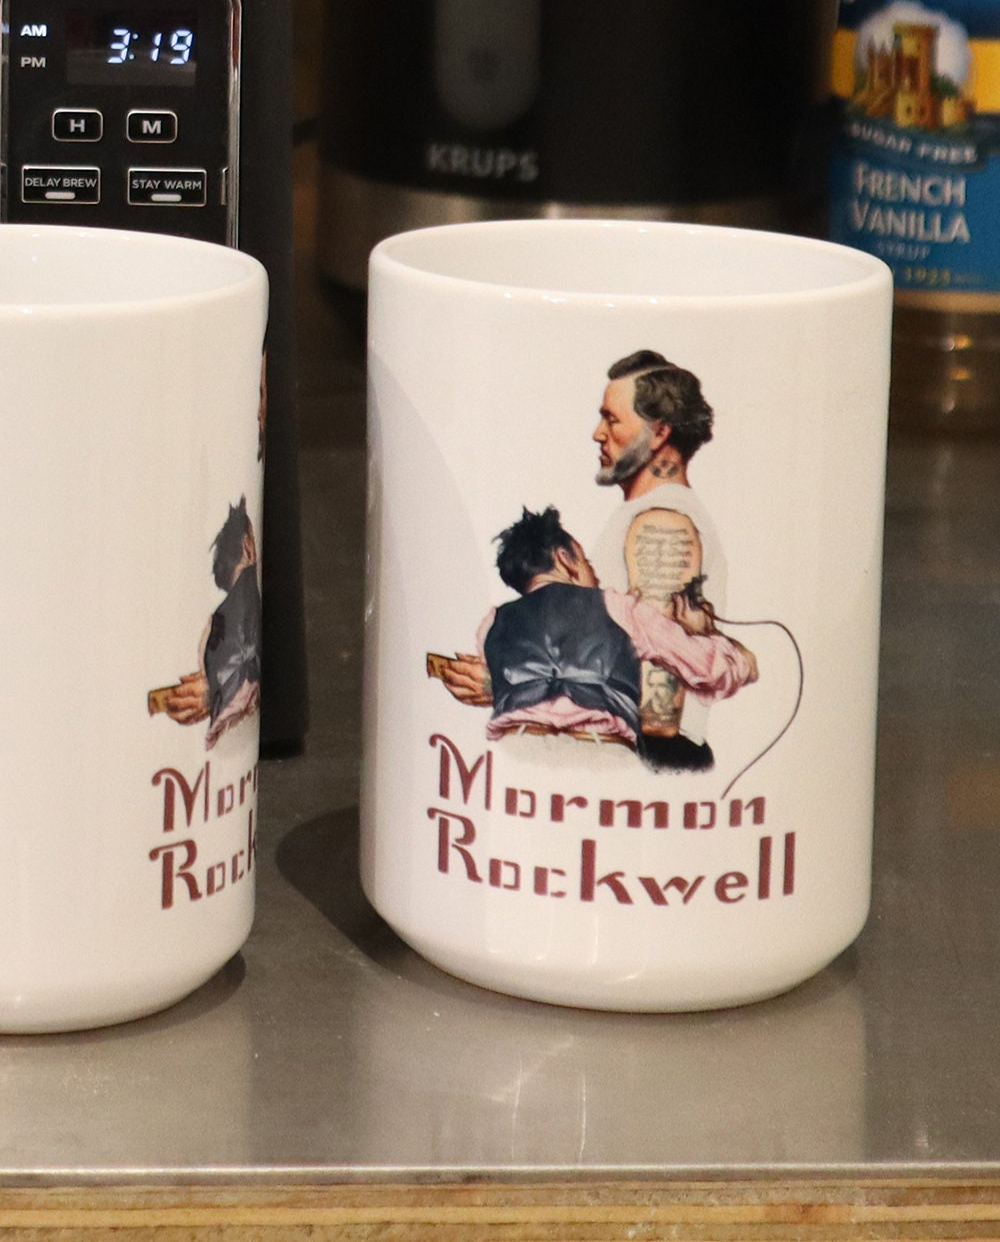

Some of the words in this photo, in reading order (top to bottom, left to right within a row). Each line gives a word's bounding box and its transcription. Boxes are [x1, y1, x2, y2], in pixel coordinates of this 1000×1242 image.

[20, 24, 47, 37] AM
[108, 28, 194, 64] 3:19
[20, 57, 46, 68] PM
[70, 119, 85, 133] H
[142, 120, 162, 134] M
[850, 122, 912, 153] SUGAR
[918, 142, 978, 164] FREE
[427, 143, 539, 181] KRUPS
[25, 177, 61, 188] DELAY
[62, 178, 97, 188] BREW
[132, 180, 160, 190] STAY
[164, 180, 202, 190] WARM
[854, 160, 967, 206] FRENCH
[851, 198, 971, 243] VANILLA
[428, 733, 766, 830] Mormon
[427, 806, 796, 907] Rockwell
